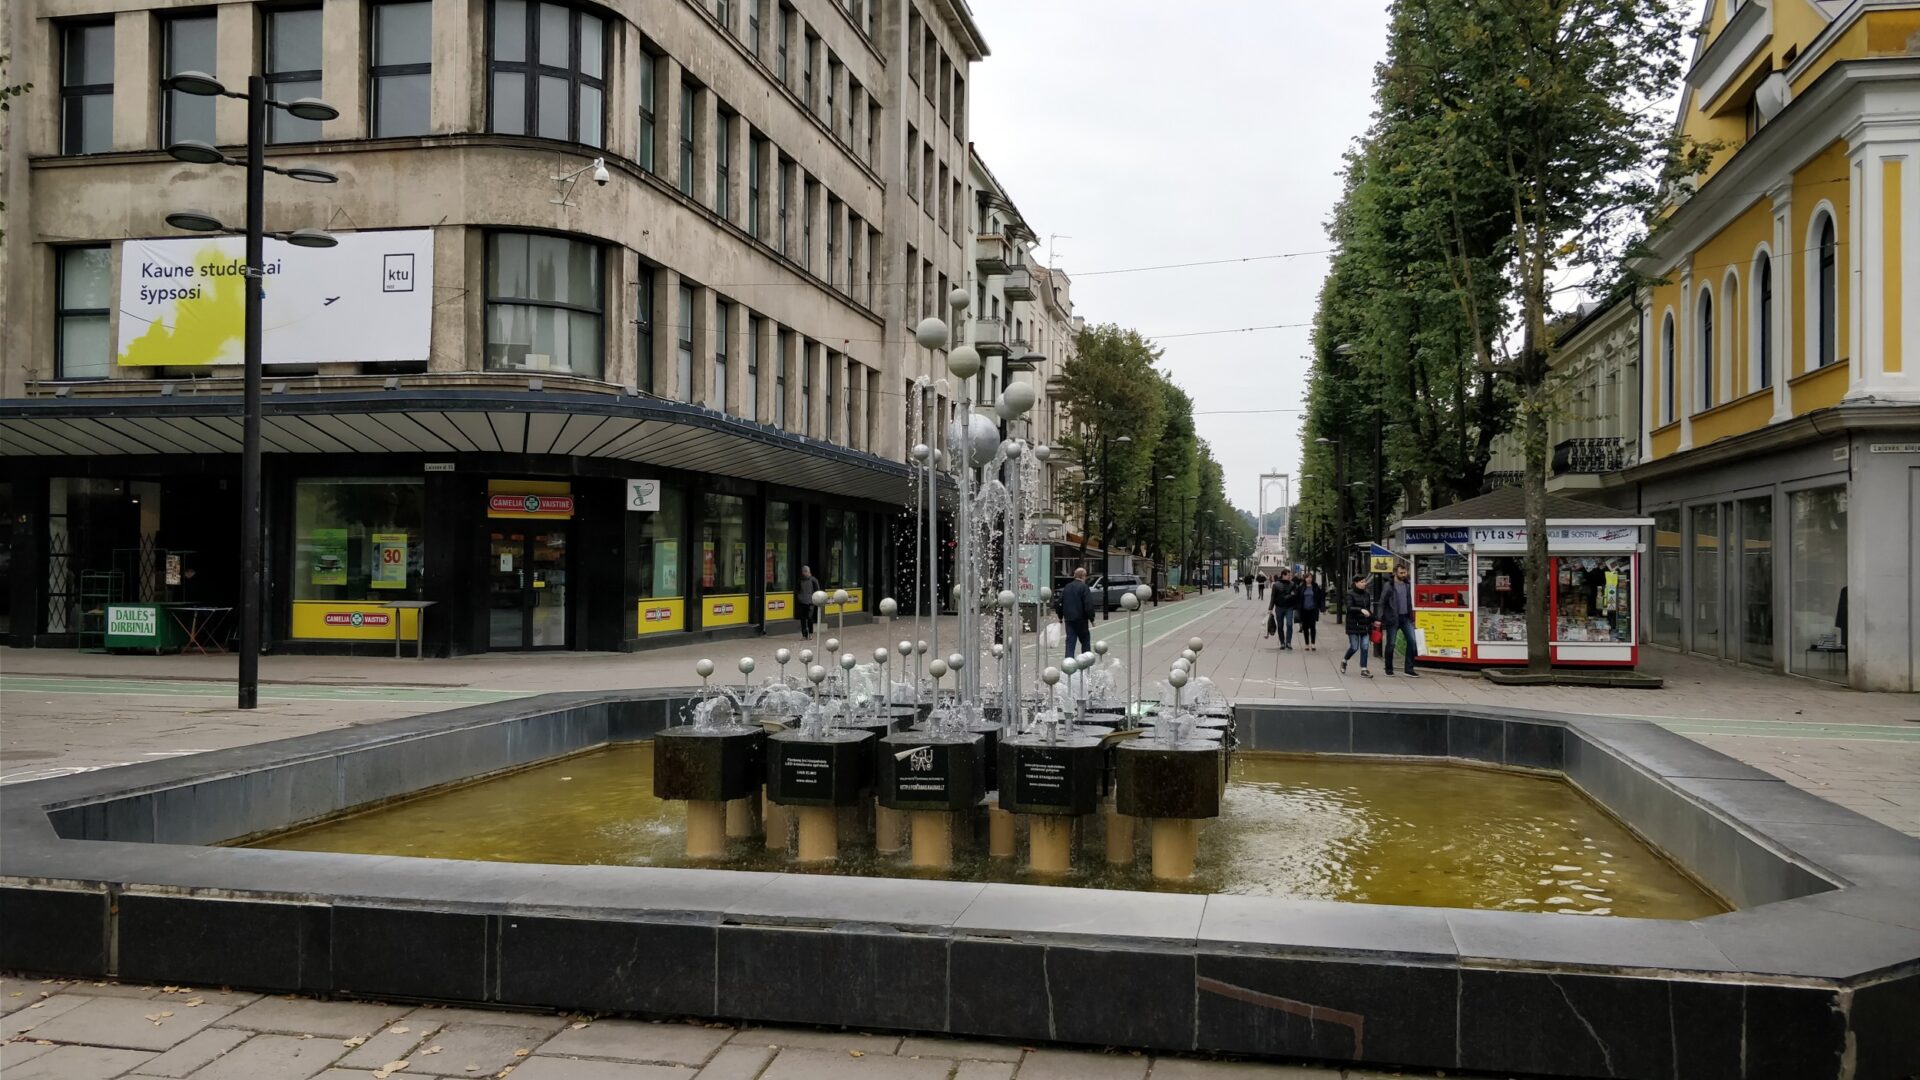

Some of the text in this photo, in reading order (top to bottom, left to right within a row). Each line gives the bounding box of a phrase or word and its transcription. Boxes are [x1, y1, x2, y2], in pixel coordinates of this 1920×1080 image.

[142, 259, 281, 278] Kaune studetai
[389, 269, 409, 281] ktu
[140, 284, 201, 304] šypsosi
[493, 498, 523, 507] CAMELIA
[1440, 531, 1468, 539] SPAUDA
[1475, 529, 1514, 541] rytas
[384, 549, 401, 564] 30
[326, 615, 350, 623] CAMELIA
[111, 621, 154, 634] DIRBINIAI
